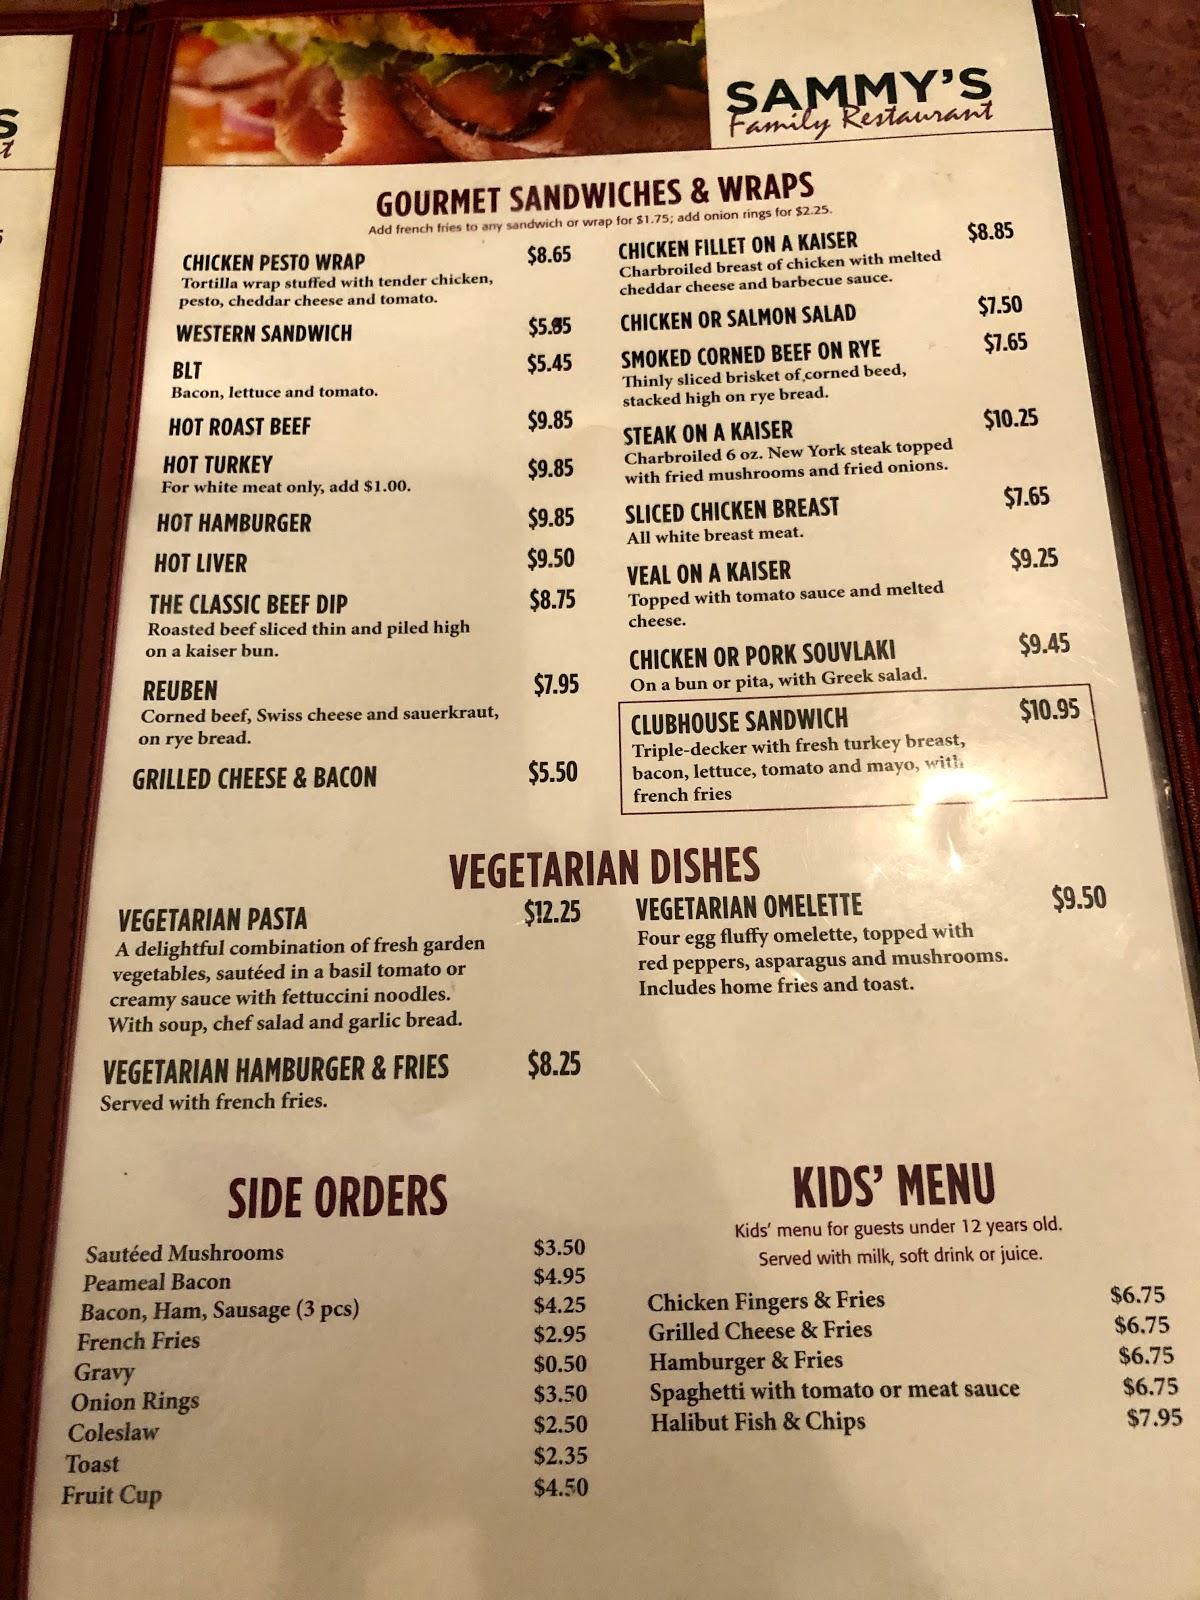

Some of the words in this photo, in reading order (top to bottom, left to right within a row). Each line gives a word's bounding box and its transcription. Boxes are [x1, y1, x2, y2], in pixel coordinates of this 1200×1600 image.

[727, 67, 992, 113] SAMMY'S
[729, 107, 831, 140] Family
[842, 100, 993, 129] Restaurant
[376, 187, 501, 217] GOURMET
[510, 178, 682, 212] SANDWICHES
[690, 177, 710, 204] &
[717, 171, 815, 202] WRAPS
[368, 224, 392, 235] Add
[396, 223, 433, 234] french
[437, 223, 462, 232] fries
[466, 223, 478, 232] to
[482, 224, 502, 232] any
[506, 218, 562, 230] sandwich
[582, 218, 613, 229] wrap
[616, 216, 633, 225] for
[636, 214, 673, 225] $1.75;
[677, 211, 700, 222] add
[704, 210, 739, 221] onion
[743, 209, 772, 221] rings
[775, 207, 792, 217] for
[795, 205, 832, 217] $2.25.
[967, 221, 1014, 244] $8.85
[527, 245, 571, 266] $8.65
[618, 239, 689, 260] CHICKEN
[695, 237, 746, 256] FILLET
[752, 235, 776, 254] ON
[781, 234, 793, 252] A
[798, 231, 858, 251] KAISER
[183, 254, 254, 271] CHICKEN
[259, 254, 310, 271] PESTO
[315, 253, 365, 271] WRAP
[181, 277, 238, 289] Tortilla
[243, 280, 281, 292] wrap
[285, 276, 336, 289] stuffed
[340, 275, 374, 288] with
[378, 274, 427, 287] tender
[431, 272, 493, 286] chicken,
[619, 282, 682, 296] cheddar
[685, 280, 735, 293] cheese
[739, 277, 768, 290] and
[771, 275, 843, 289] barbecue
[846, 274, 893, 285] sauce.
[621, 348, 692, 369] SMOKED
[697, 345, 766, 366] CORNED
[771, 342, 812, 363] BEEF
[818, 341, 843, 360] ON
[848, 339, 882, 359] RYE
[984, 332, 1028, 355] $7.65
[172, 361, 203, 380] BLT
[527, 353, 572, 375] $5.45
[169, 417, 204, 436] HOT
[209, 417, 265, 436] ROAST
[270, 417, 311, 436] BEEF
[528, 409, 573, 433] $9.85
[624, 448, 722, 465] Charbroiled
[726, 448, 736, 461] 6
[740, 450, 763, 460] oz.
[767, 446, 804, 459] New
[807, 443, 846, 457] York
[850, 441, 892, 455] steak
[896, 437, 954, 456] topped
[161, 480, 190, 493] For
[194, 480, 238, 493] white
[242, 482, 282, 493] meat
[286, 480, 325, 497] only,
[329, 479, 359, 493] add
[364, 480, 411, 493] $1.00.
[1004, 486, 1050, 510] $7.65
[625, 503, 684, 524] SLICED
[690, 499, 767, 522] CHICKEN
[772, 496, 839, 518] BREAST
[150, 594, 184, 615] THE
[189, 594, 261, 615] CLASSIC
[267, 594, 311, 614] BEEF
[316, 594, 348, 614] DIP
[530, 588, 576, 613] $8.75
[631, 711, 740, 736] CLUBHOUSE
[745, 707, 848, 732] SANDWICH
[1019, 697, 1080, 724] $10.95
[632, 740, 748, 762] Triple-decker
[751, 738, 791, 754] with
[795, 736, 839, 752] fresh
[844, 735, 901, 753] turkey
[905, 734, 966, 748] breast,
[133, 768, 211, 790] GRILLED
[218, 767, 287, 789] CHEESE
[293, 767, 307, 789] &
[313, 765, 377, 788] BACON
[528, 760, 578, 786] $5.50
[449, 849, 639, 890] VEGETARIAN
[651, 846, 760, 885] DISHES
[635, 895, 757, 921] VEGETARIAN
[764, 892, 863, 918] OMELETTE
[1052, 884, 1107, 913] $9.50
[119, 907, 241, 932] VEGETARIAN
[247, 906, 307, 931] PASTA
[524, 898, 581, 927] $12.25
[637, 930, 681, 946] Four
[685, 933, 716, 950] egg
[720, 927, 769, 948] fluffy
[773, 925, 858, 944] omelette,
[863, 923, 928, 945] topped
[932, 922, 974, 939] with
[103, 1058, 229, 1085] VEGETARIAN
[236, 1055, 365, 1083] HAMBURGER
[371, 1055, 386, 1080] &
[393, 1053, 449, 1080] FRIES
[528, 1049, 581, 1080] $8.25
[100, 1093, 164, 1112] Served
[169, 1093, 210, 1111] with
[216, 1092, 275, 1110] french
[281, 1091, 327, 1109] fries.
[228, 1176, 303, 1219] SIDE
[315, 1173, 448, 1218] ORDERS
[793, 1165, 883, 1208] KIDS'
[897, 1162, 995, 1206] MENU
[735, 1222, 771, 1238] Kids'
[777, 1225, 822, 1237] menu
[827, 1220, 849, 1236] for
[854, 1221, 904, 1240] guests
[909, 1218, 956, 1234] under
[962, 1219, 982, 1233] 12
[986, 1220, 1028, 1237] years
[1033, 1215, 1062, 1232] old.
[85, 1244, 163, 1264] Sautéed
[167, 1243, 284, 1262] Mushrooms
[534, 1238, 586, 1257] $3.50
[534, 1296, 586, 1315] $4.25
[647, 1292, 729, 1312] Chicken
[735, 1292, 809, 1316] Fingers
[814, 1290, 831, 1309] &
[835, 1290, 885, 1308] Fries
[1110, 1285, 1165, 1305] $6.75
[80, 1303, 147, 1323] Bacon,
[153, 1302, 207, 1321] Ham,
[213, 1300, 291, 1324] Sausage
[296, 1298, 315, 1321] (3
[320, 1298, 359, 1323] pcs)
[534, 1384, 588, 1404] $3.50
[650, 1381, 746, 1407] Spaghetti
[750, 1380, 796, 1400] with
[801, 1382, 874, 1399] tomato
[879, 1385, 902, 1399] or
[908, 1381, 959, 1398] meat
[964, 1383, 1020, 1398] sauce
[1123, 1377, 1179, 1397] $6.75
[71, 1392, 136, 1412] Onion
[142, 1391, 200, 1416] Rings
